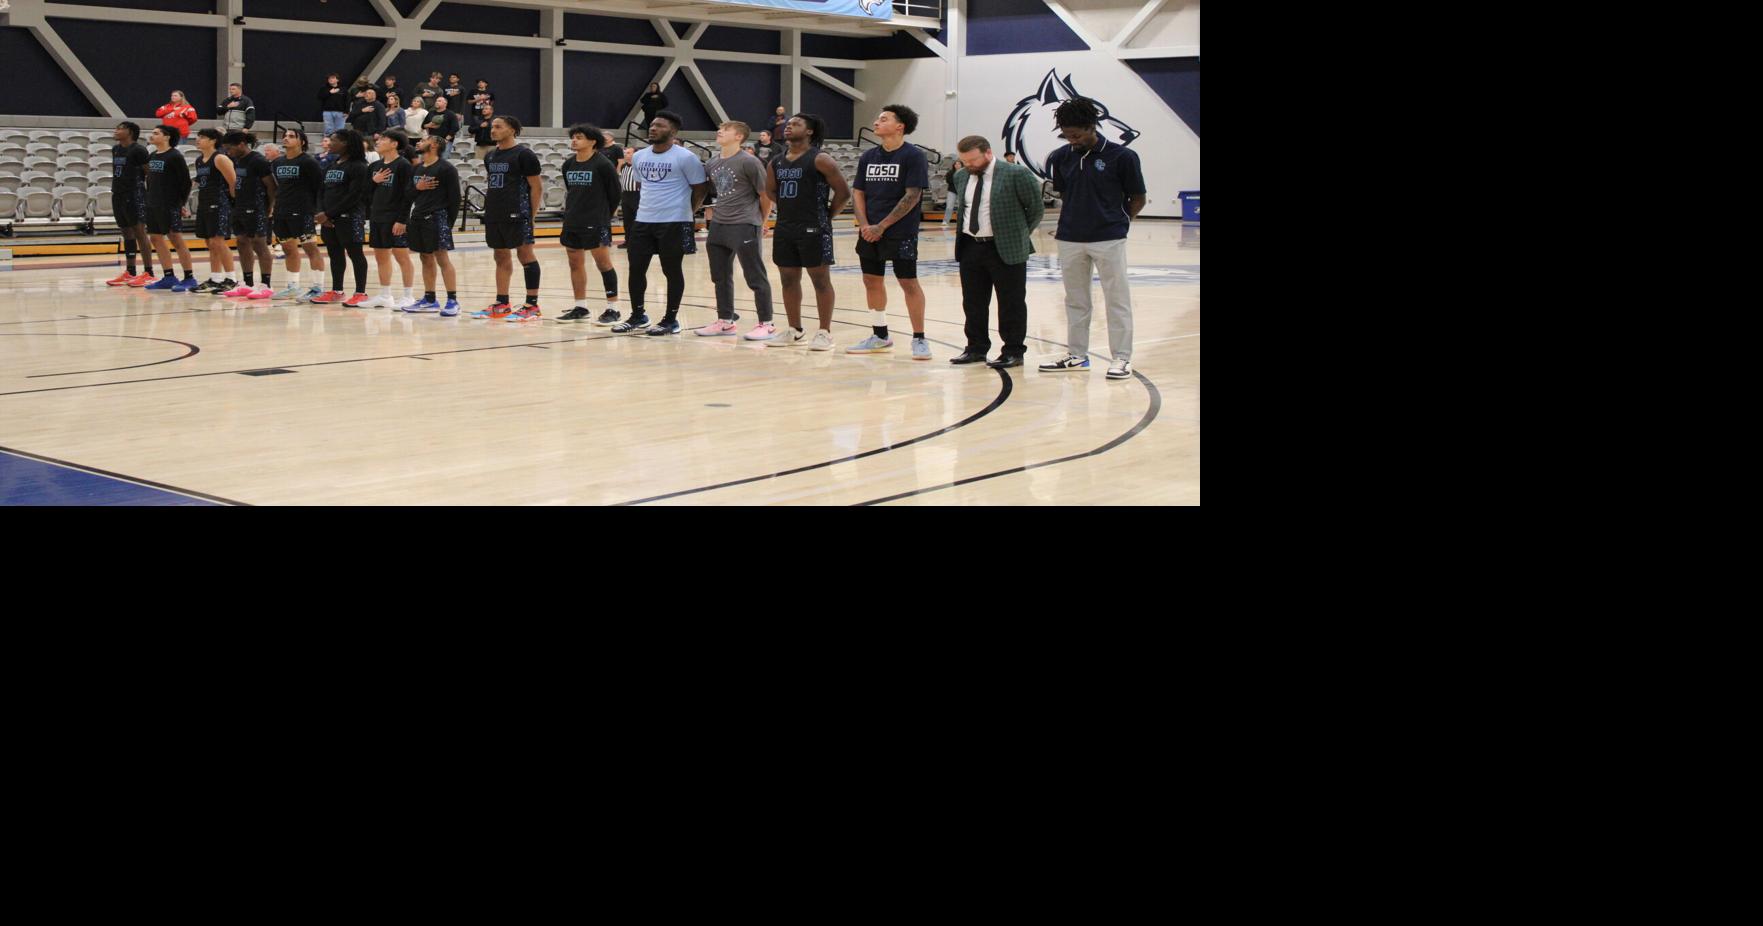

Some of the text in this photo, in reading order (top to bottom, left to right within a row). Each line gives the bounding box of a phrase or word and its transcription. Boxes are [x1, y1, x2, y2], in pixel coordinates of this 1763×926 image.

[277, 166, 299, 175] COSO
[567, 171, 592, 181] COSO
[867, 165, 898, 176] COSO
[489, 173, 504, 188] 21
[780, 181, 798, 198] 10
